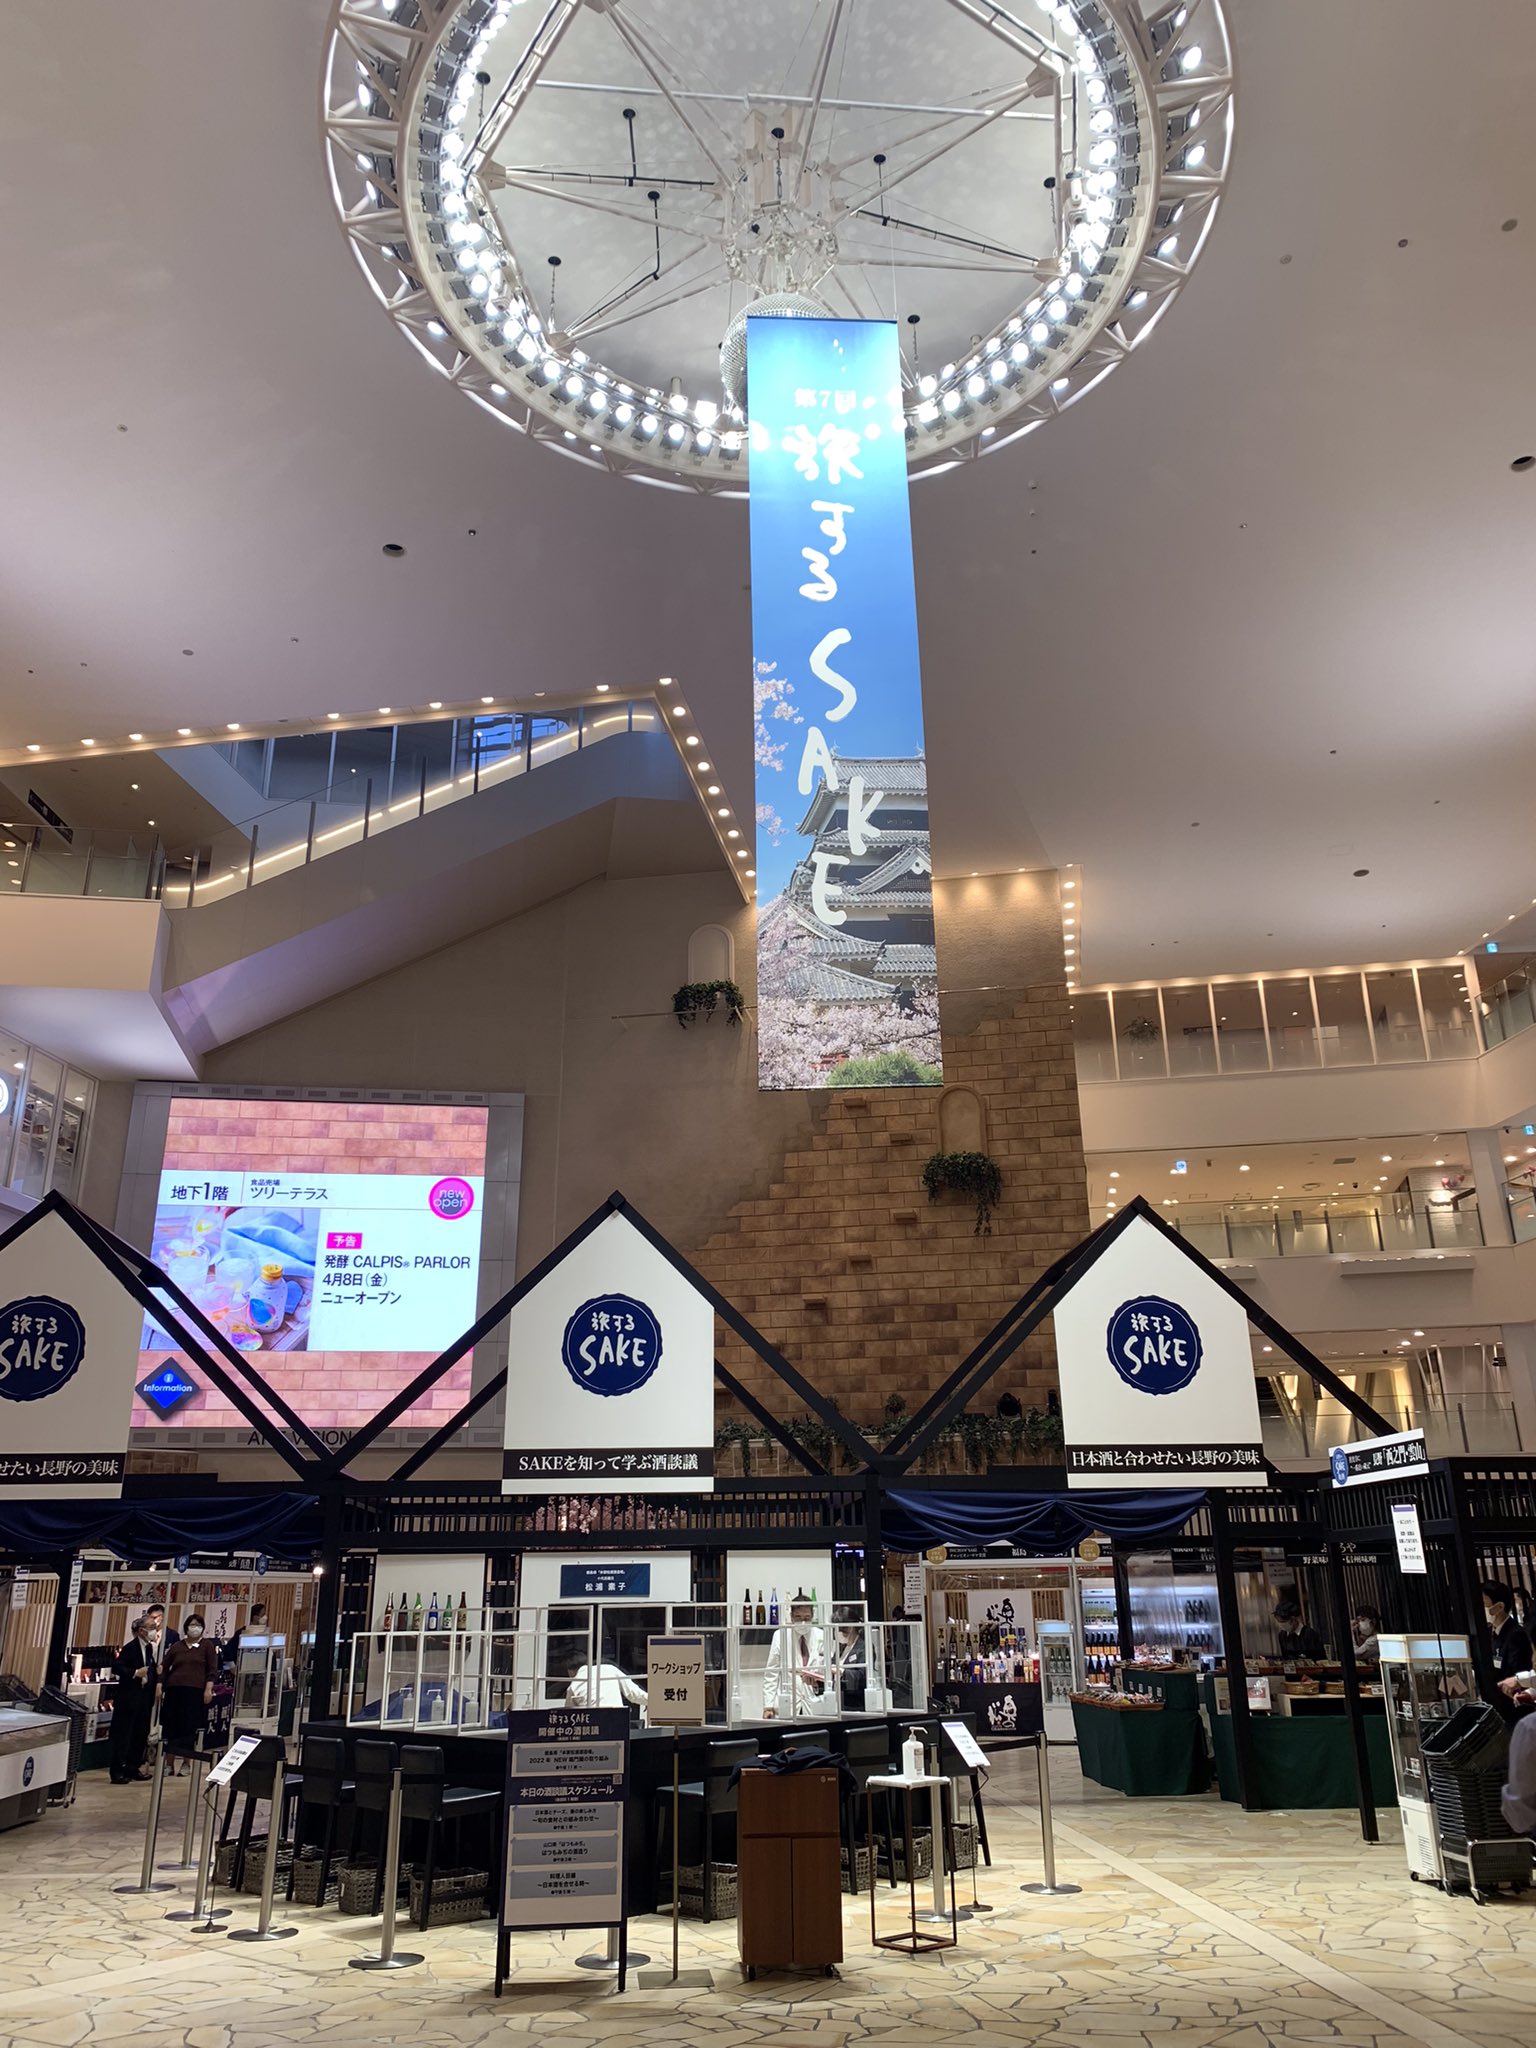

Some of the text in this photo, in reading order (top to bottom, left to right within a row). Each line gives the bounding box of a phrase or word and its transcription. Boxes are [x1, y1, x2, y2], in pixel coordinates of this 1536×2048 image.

[797, 626, 885, 927] SAKE
[171, 1183, 229, 1201] 地下1階
[251, 1187, 329, 1201] ツリーテラス
[433, 1197, 468, 1210] open
[332, 1235, 357, 1248] 予告
[324, 1254, 349, 1269] 発酵
[414, 1255, 471, 1269] PARLOR
[320, 1290, 403, 1306] ニューオープン
[12, 1314, 58, 1336] 旅する
[591, 1311, 635, 1333] 旅する
[1131, 1313, 1174, 1333] 旅する
[579, 1334, 648, 1376] SAKE
[1123, 1334, 1188, 1375] SAKE
[143, 1382, 194, 1393] Information
[519, 1453, 699, 1472] SAKEを知って学ぶ酒談議
[1072, 1449, 1261, 1467] 日本酒と合わせたい長野の美味
[651, 1661, 701, 1675] ワークショップ
[664, 1688, 688, 1702] 受付
[570, 1713, 591, 1726] SAKE
[520, 1785, 615, 1798] 本日の酒談議スケジュール
